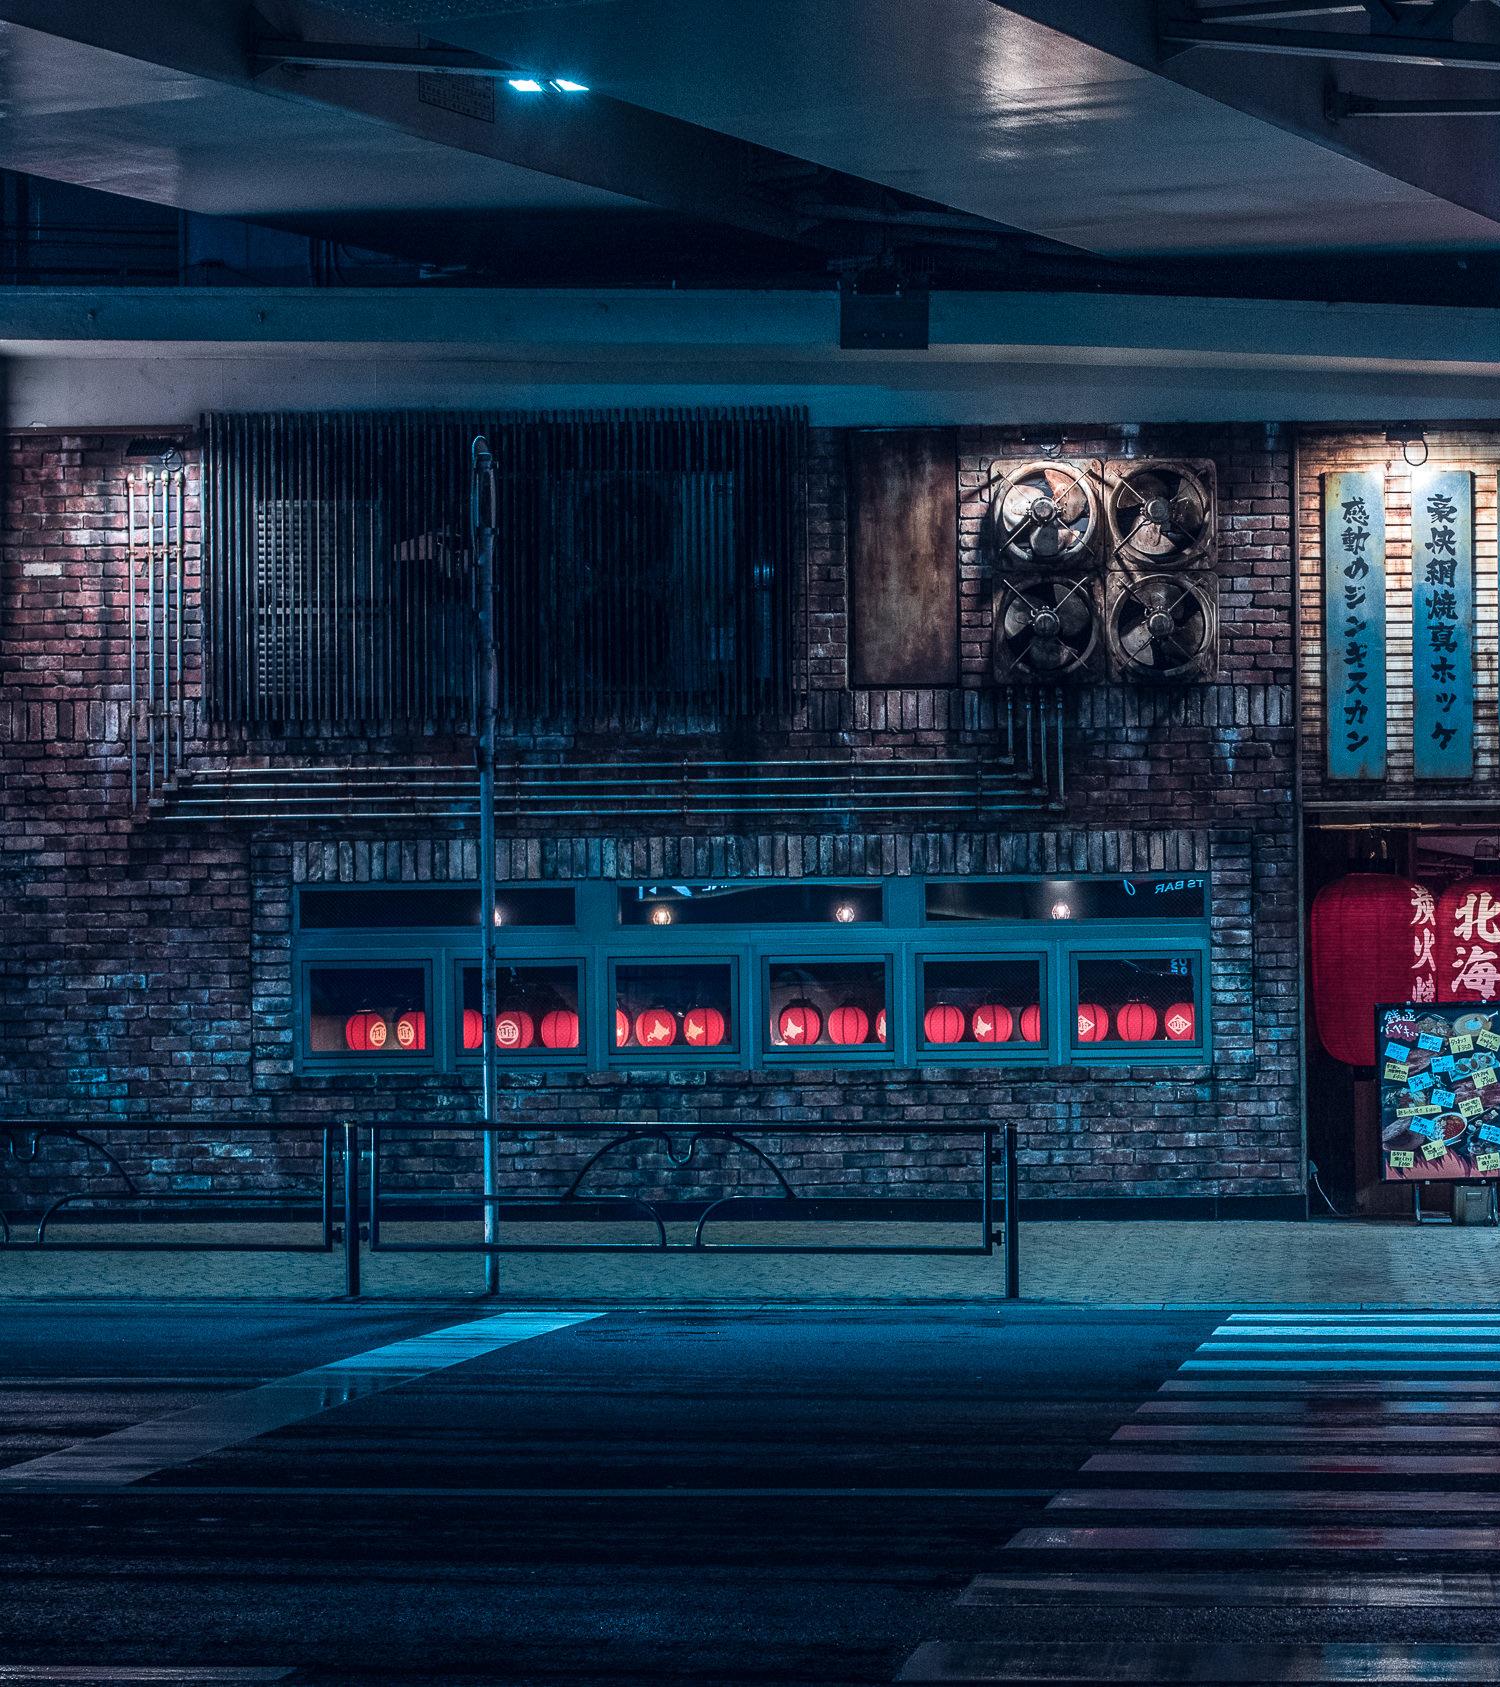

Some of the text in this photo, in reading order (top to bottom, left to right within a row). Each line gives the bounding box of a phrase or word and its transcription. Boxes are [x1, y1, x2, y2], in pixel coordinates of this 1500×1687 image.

[1341, 496, 1370, 752] 感動のジンギスカン
